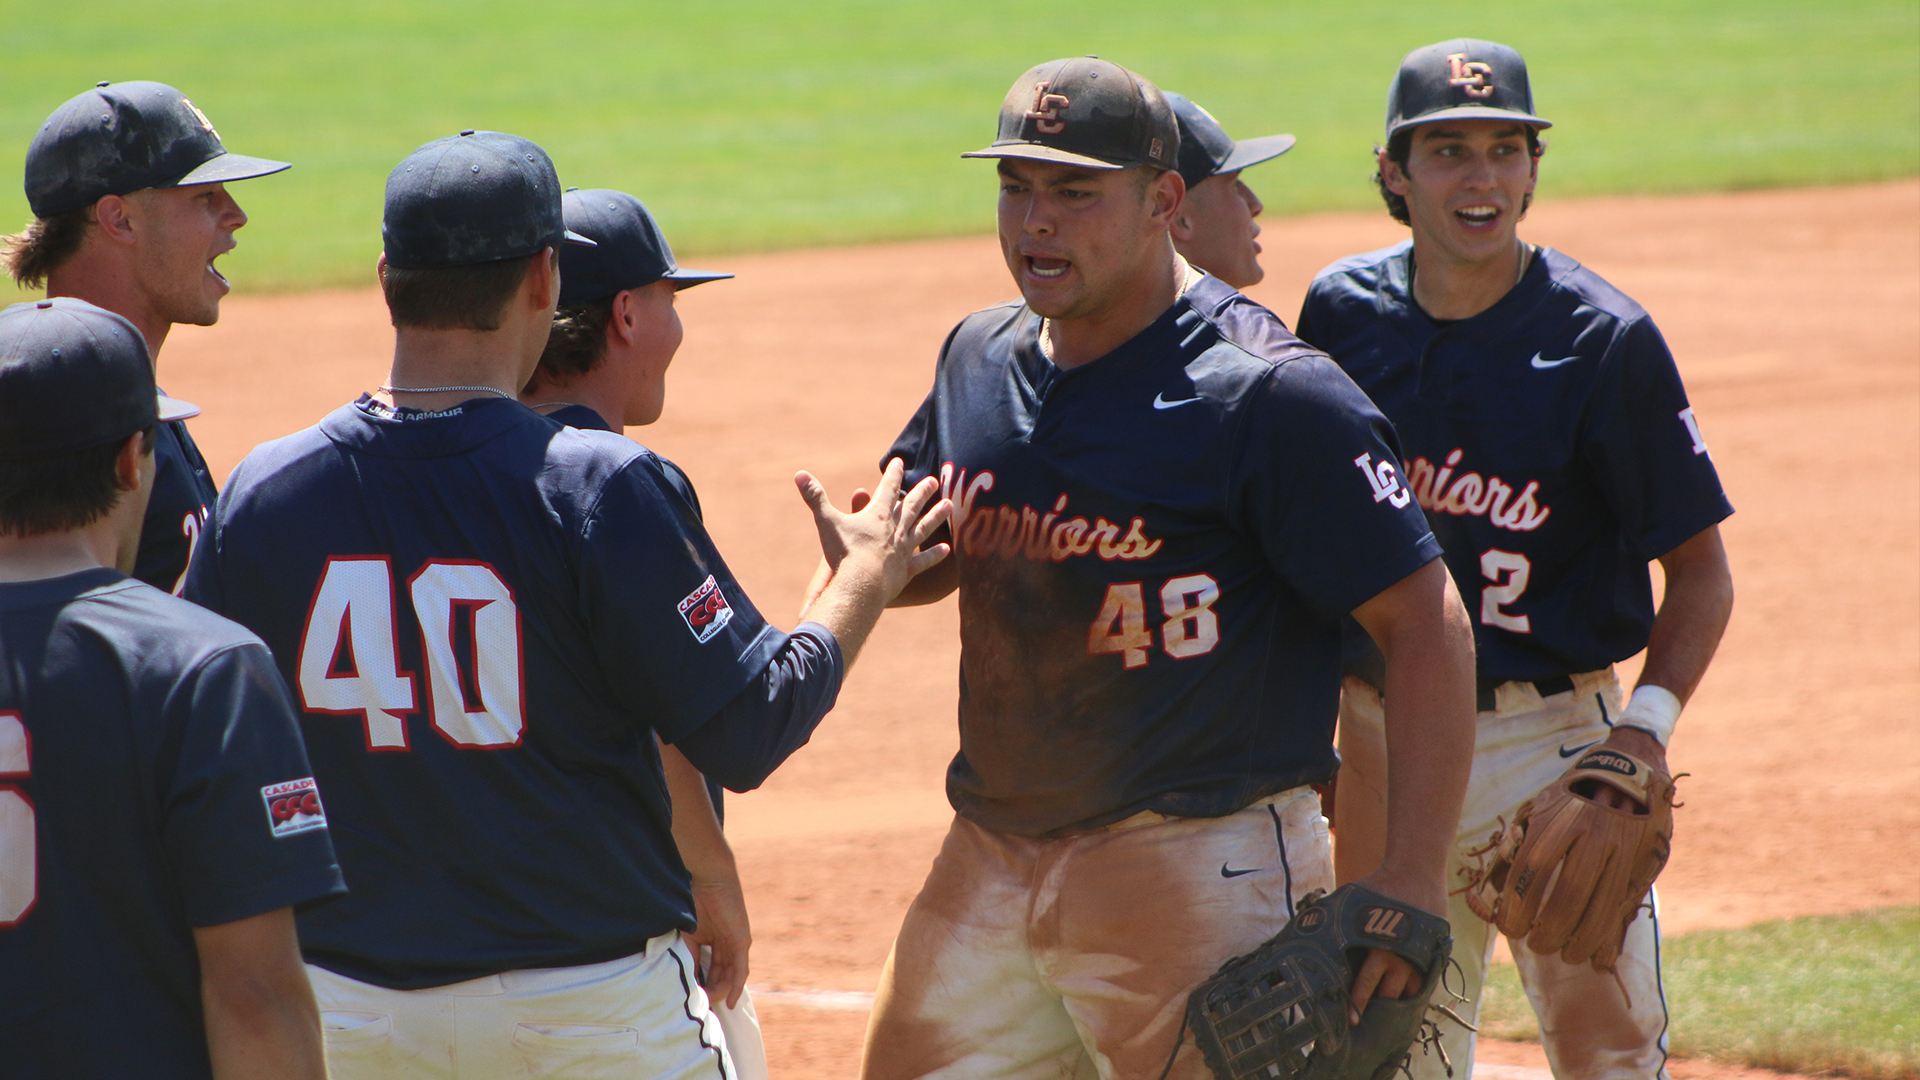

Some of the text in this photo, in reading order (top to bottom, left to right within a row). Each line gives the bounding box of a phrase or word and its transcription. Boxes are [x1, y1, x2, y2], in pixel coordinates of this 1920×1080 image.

[1446, 53, 1494, 98] LC
[1026, 81, 1070, 135] LC
[405, 407, 463, 420] ARMOUR
[1353, 451, 1411, 509] LC
[940, 461, 1164, 562] Warriors
[1479, 547, 1532, 634] 2
[1088, 571, 1221, 670] 48
[296, 554, 528, 752] 40
[264, 780, 315, 796] CASCADE
[1581, 755, 1631, 773] Wilson
